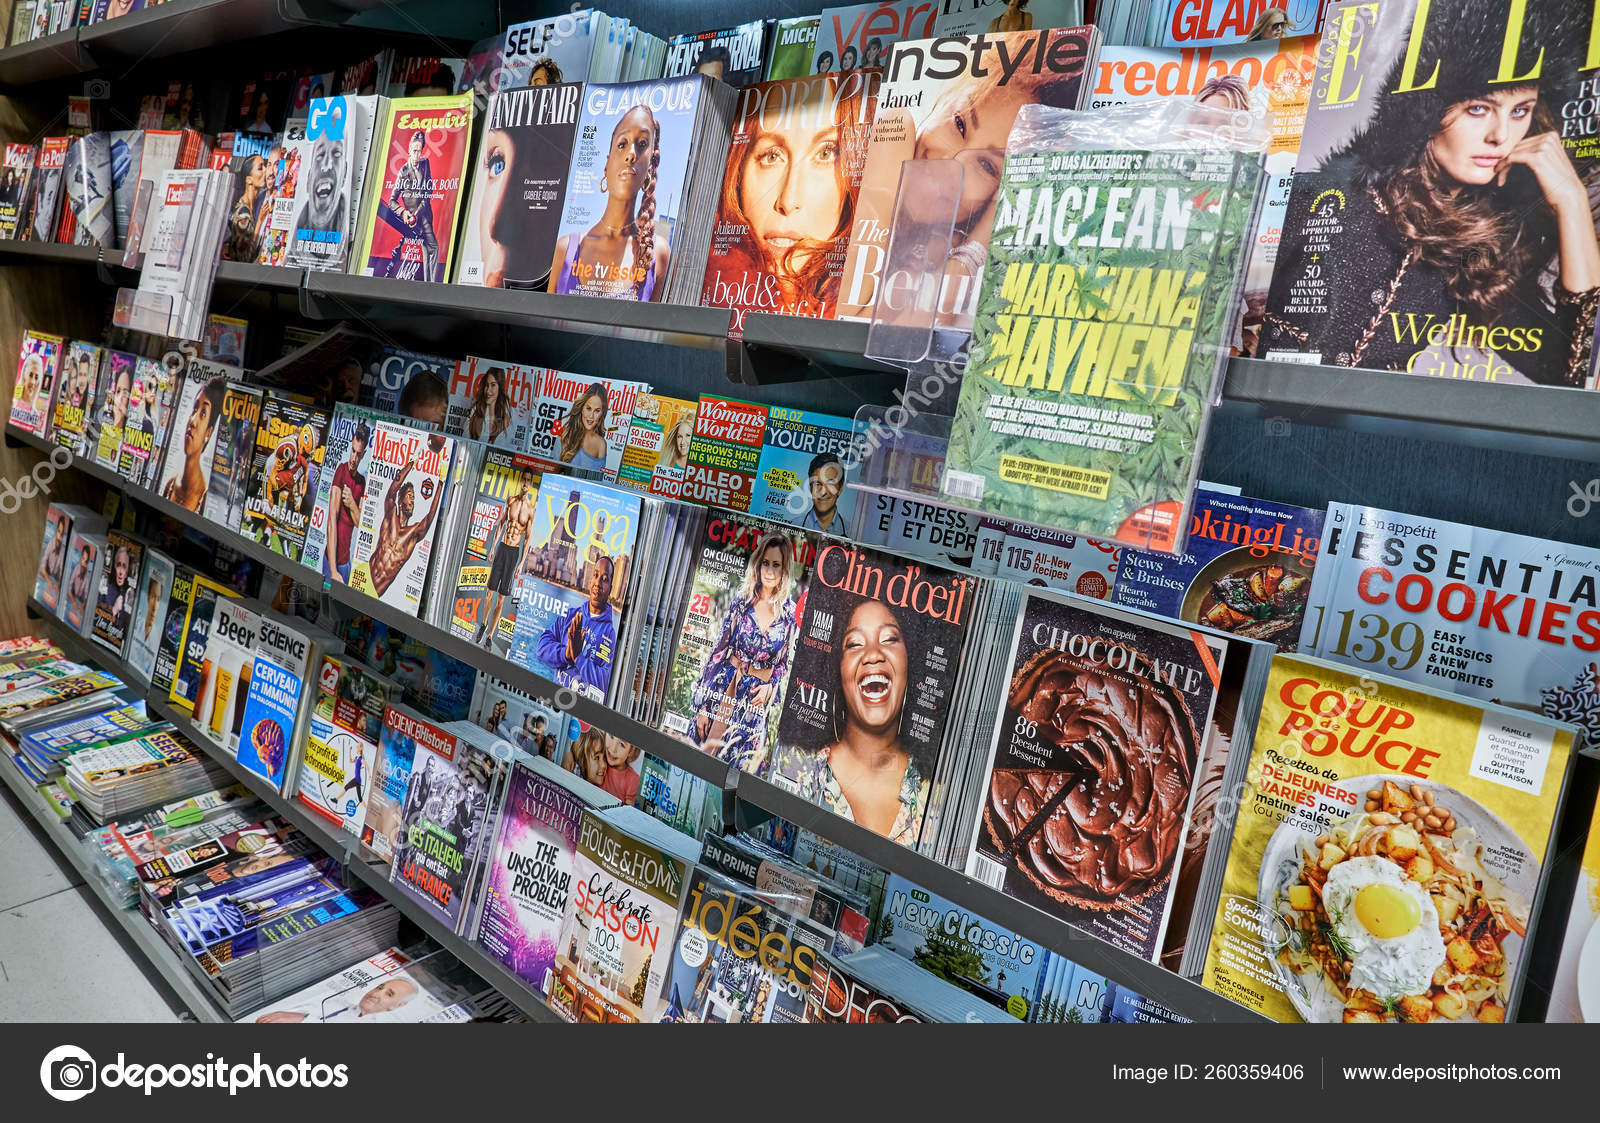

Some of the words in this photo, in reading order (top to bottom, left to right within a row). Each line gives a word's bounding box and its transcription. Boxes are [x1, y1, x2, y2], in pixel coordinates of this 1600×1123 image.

[506, 24, 554, 58] SELF
[1316, 16, 1342, 99] CANADA
[536, 85, 578, 126] FAIR
[587, 82, 697, 116] GLAMOUR
[881, 88, 923, 109] Janet
[306, 95, 348, 142] GQ
[398, 112, 468, 130] Esquire
[1061, 156, 1078, 170] HAS
[1079, 154, 1142, 171] ALZHEIMER'S
[438, 178, 460, 191] BOOK
[1306, 217, 1340, 227] EDITOR-
[1318, 203, 1334, 218] 45
[856, 218, 890, 242] The
[1301, 225, 1342, 236] APPROVED
[1309, 235, 1329, 244] FALL
[1303, 244, 1330, 253] COATS
[572, 259, 592, 276] the
[595, 265, 607, 279] tv
[608, 264, 647, 283] issue
[1303, 265, 1321, 279] 50
[1290, 288, 1327, 296] WINNING
[1295, 279, 1326, 288] AWARD-
[1284, 305, 1328, 314] PRODUCTS
[1291, 296, 1323, 305] BEAUTY
[1389, 312, 1543, 352] Wellness
[538, 402, 567, 420] GET
[700, 401, 767, 428] Woman's
[631, 429, 640, 437] SO
[641, 431, 660, 441] LONG
[696, 418, 744, 442] World
[770, 426, 815, 452] YOUR
[785, 422, 803, 432] GOOD
[804, 426, 817, 434] LIFE
[532, 433, 556, 451] GO!
[630, 437, 657, 449] STRESS!
[691, 442, 733, 458] REGROWS
[735, 449, 757, 462] HAIR
[656, 466, 667, 476] The
[689, 451, 698, 460] IN
[699, 453, 704, 461] 6
[706, 455, 738, 469] WEEKS
[1003, 459, 1017, 468] PLUS:
[1018, 461, 1049, 474] EVERYTHING
[685, 466, 742, 490] PALEO
[682, 482, 730, 505] CURE
[311, 506, 324, 529] 50
[476, 501, 500, 517] MOVES
[1209, 499, 1227, 508] What
[1228, 503, 1253, 514] Healthy
[1254, 507, 1277, 517] Means
[1277, 512, 1293, 520] Now
[538, 494, 632, 566] yoga
[1012, 520, 1074, 544] magazine
[1387, 519, 1438, 540] appétit
[703, 548, 714, 560] ON
[715, 551, 745, 568] CUISINE
[1007, 546, 1033, 571] 115
[1035, 552, 1072, 570] All-New
[1125, 554, 1163, 572] Stews
[817, 545, 884, 601] Clin
[1033, 563, 1069, 581] Recipes
[1122, 567, 1134, 580] &
[1137, 569, 1185, 591] Braises
[1118, 593, 1157, 609] Vegetable
[1120, 585, 1149, 597] Hearty
[455, 596, 483, 622] SEX
[521, 591, 570, 618] FUTURE
[690, 594, 711, 616] 25
[1357, 566, 1600, 652] COOKIES
[216, 612, 256, 650] Beer
[812, 609, 834, 632] YAMA
[259, 627, 305, 660] SCIENCE
[1099, 624, 1112, 634] bon
[1113, 627, 1137, 642] appétit
[1434, 629, 1466, 646] EASY
[1032, 622, 1203, 696] CHOCOLATE
[1429, 653, 1438, 662] &
[1440, 655, 1468, 670] NEW
[1431, 641, 1494, 664] CLASSICS
[255, 662, 297, 695] CERVEAU
[1426, 664, 1495, 689] FAVORITES
[793, 685, 829, 713] AIR
[1279, 677, 1416, 735] COUP
[797, 705, 828, 723] parfums
[1014, 716, 1039, 739] 86
[1501, 725, 1532, 739] FAMILLE
[150, 733, 190, 765] SEEKS
[420, 724, 453, 755] Historia
[1011, 733, 1053, 759] Decadent
[1278, 710, 1441, 779] POUCE
[1488, 733, 1518, 749] Quand
[1519, 740, 1540, 755] papa
[1008, 745, 1046, 769] Desserts
[1490, 744, 1499, 753] et
[1500, 746, 1533, 761] maman
[1493, 752, 1526, 767] doivent
[1267, 749, 1320, 775] Recettes
[1322, 769, 1339, 781] de
[1479, 764, 1500, 776] LEUR
[1501, 770, 1534, 787] MAISON
[1490, 760, 1525, 775] QUITTER
[1262, 763, 1358, 806] DÉJEUNERS
[1256, 793, 1297, 814] matins
[1300, 806, 1331, 827] salés
[1260, 778, 1316, 808] VARIÉS
[1319, 802, 1350, 819] pour
[1254, 804, 1272, 821] (ou
[425, 836, 463, 874] ITALIENS
[536, 841, 560, 866] THE
[580, 822, 622, 868] HOUSE
[621, 852, 632, 873] &
[633, 857, 678, 898] HOME
[705, 844, 720, 862] EN
[722, 851, 757, 879] PRIME
[403, 859, 415, 881] LA
[416, 866, 453, 906] FRANCE
[588, 872, 653, 924] Celebrate
[574, 880, 660, 952] SEASON
[1225, 897, 1269, 924] Spécial
[626, 921, 638, 933] THE
[683, 881, 817, 987] idées
[889, 891, 939, 929] New
[943, 909, 1035, 966] Classic
[1223, 910, 1280, 945] SOMMEIL
[928, 930, 960, 950] COTTAGE
[961, 941, 981, 955] WITH
